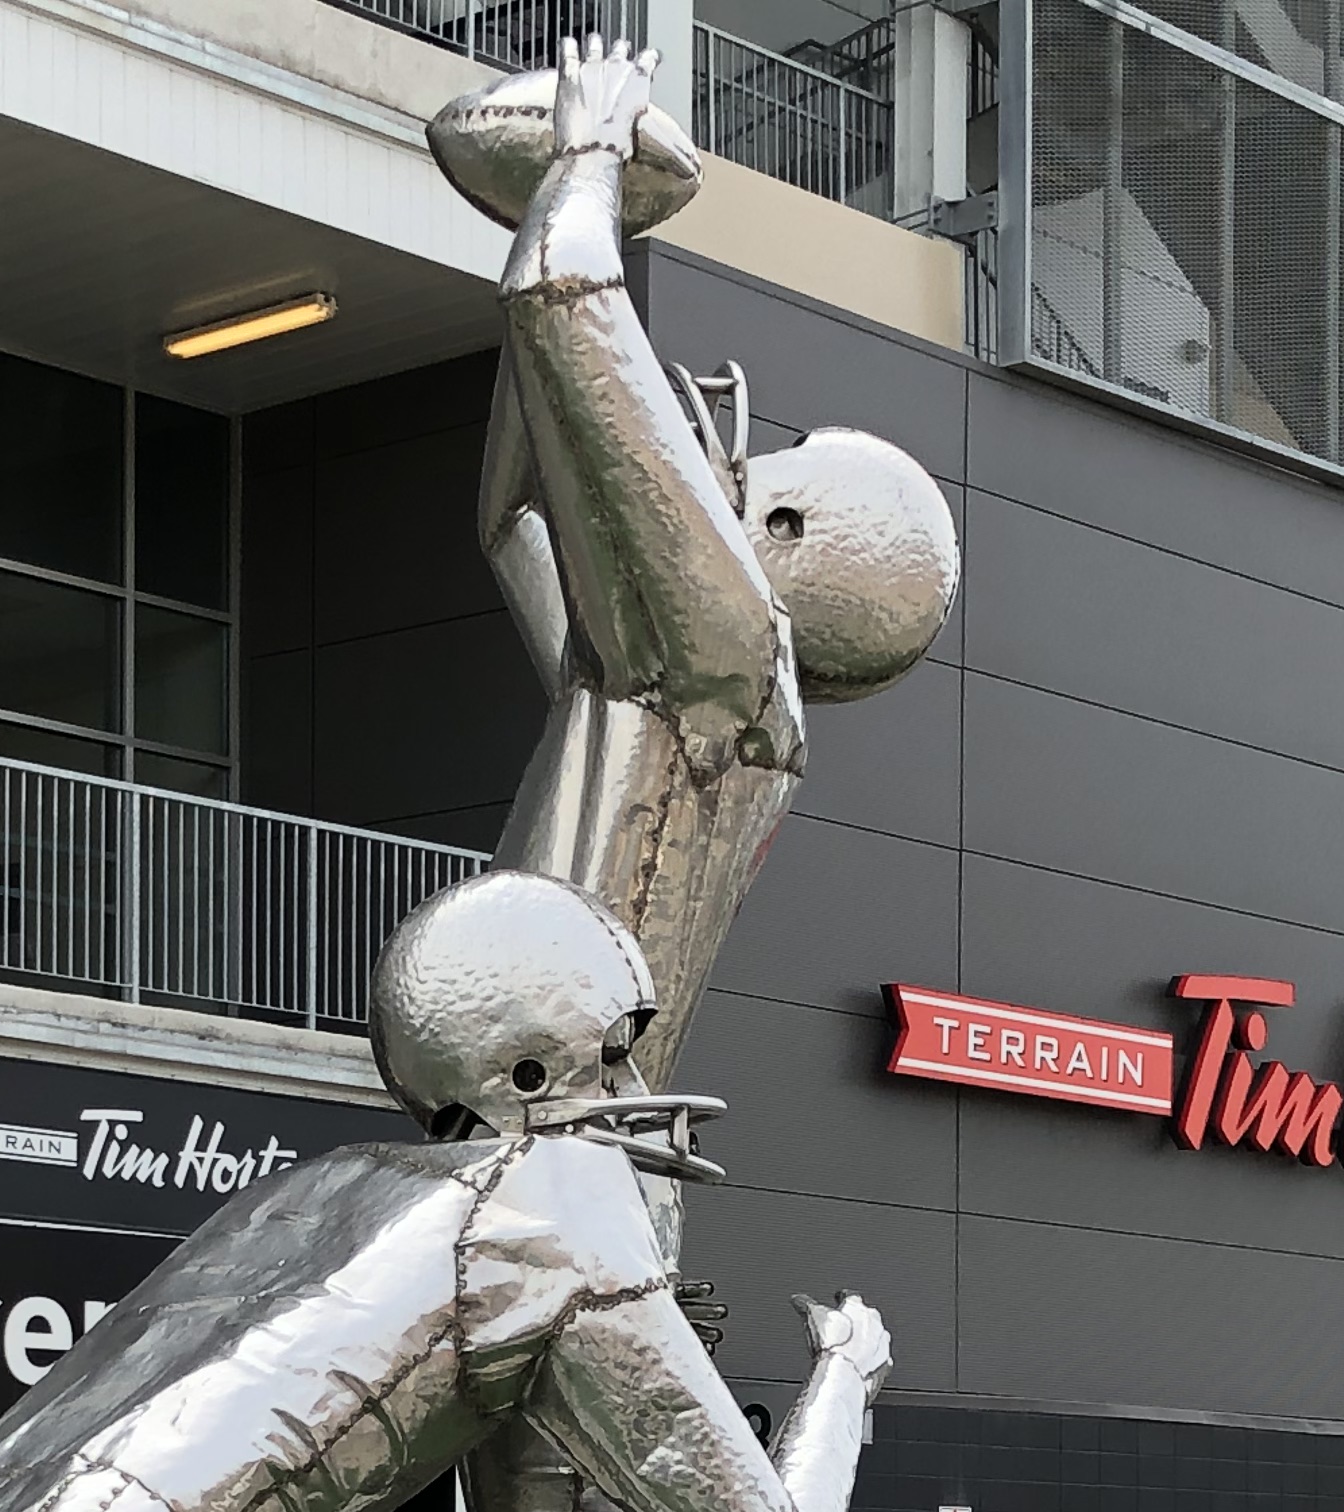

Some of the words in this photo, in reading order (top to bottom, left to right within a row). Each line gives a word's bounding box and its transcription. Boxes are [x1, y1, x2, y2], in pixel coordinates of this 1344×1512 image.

[931, 1015, 1146, 1088] TERRAIN
[1169, 974, 1340, 1168] Tim
[79, 1108, 170, 1188] Tim
[173, 1113, 298, 1194] Hort
